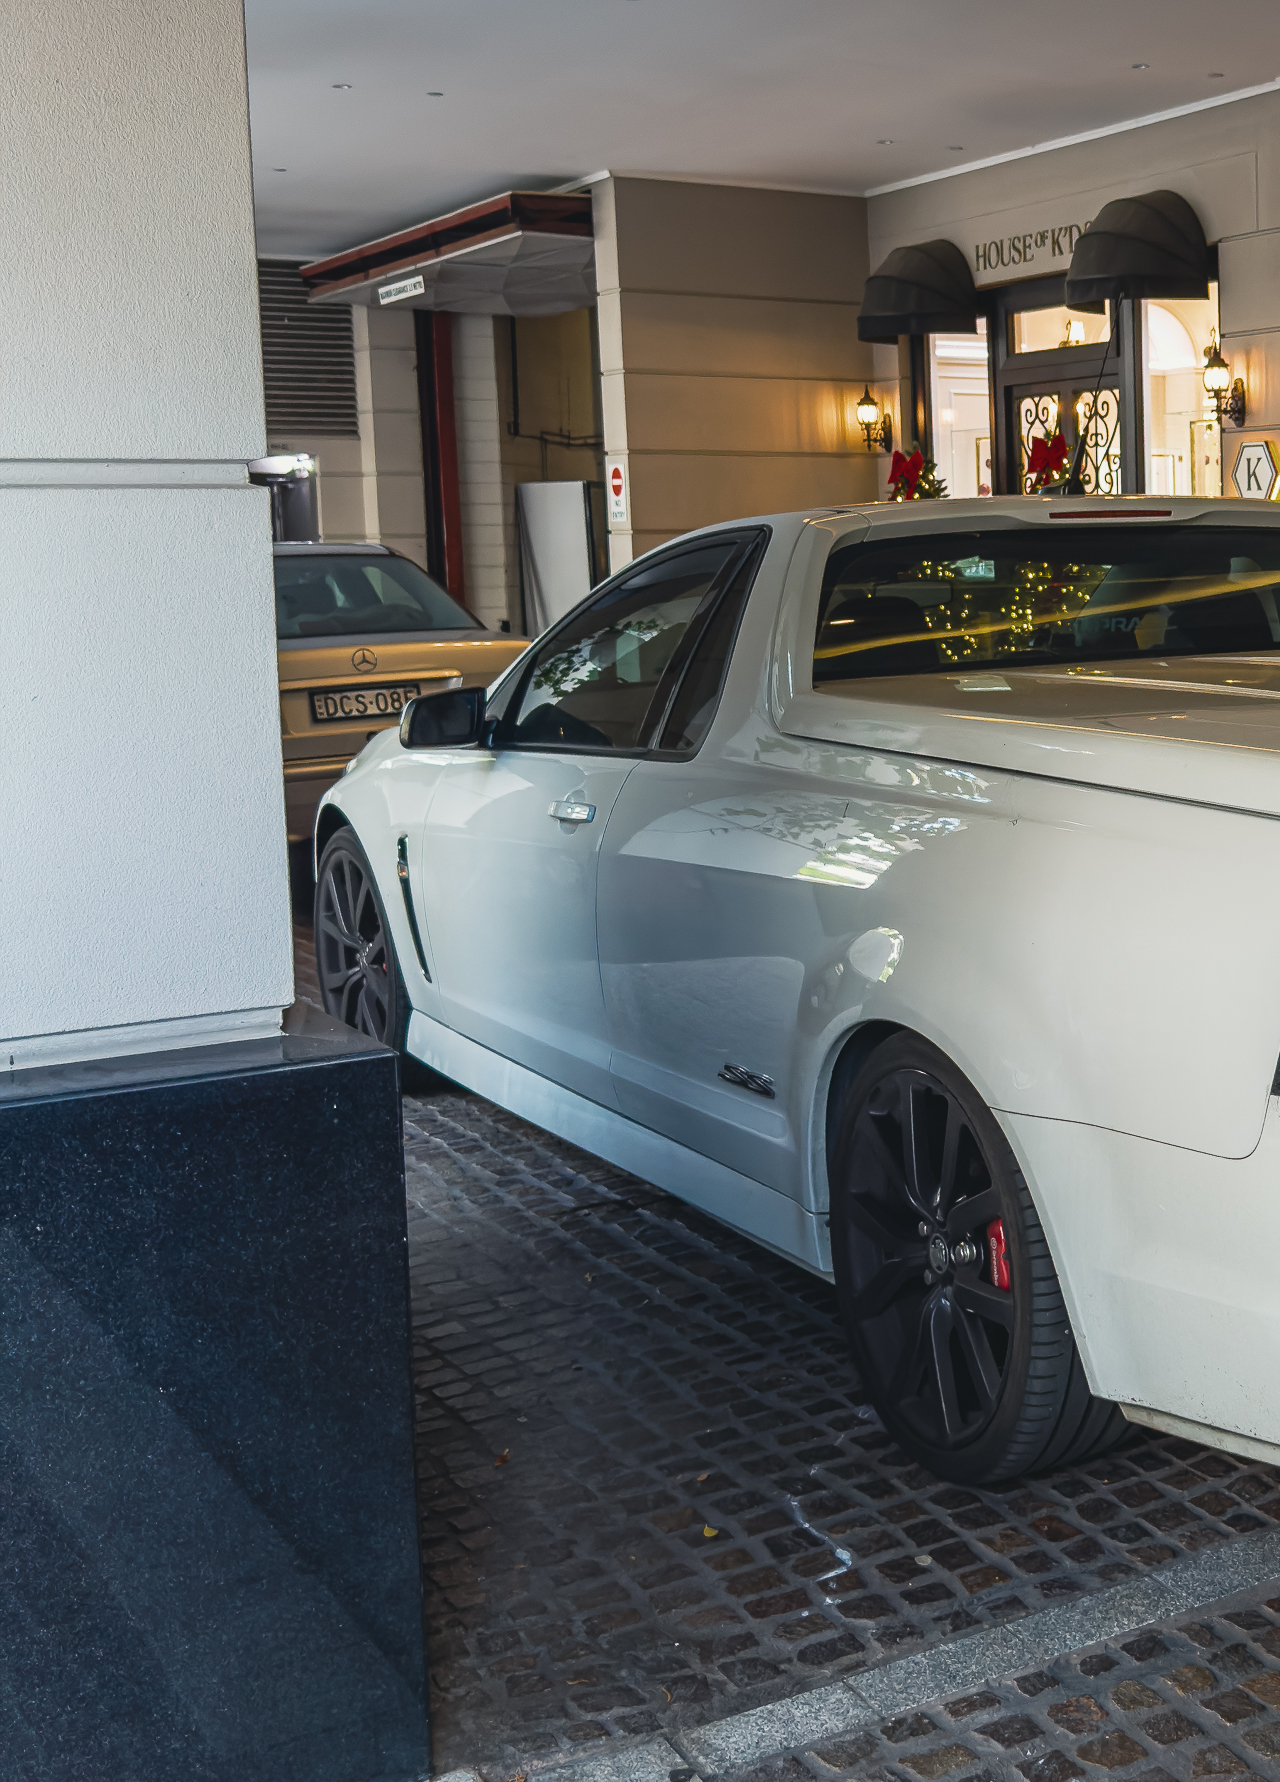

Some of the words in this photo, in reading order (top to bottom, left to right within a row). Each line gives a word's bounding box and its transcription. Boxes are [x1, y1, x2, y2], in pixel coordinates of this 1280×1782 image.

[975, 233, 1035, 272] HOUSE
[1034, 229, 1049, 249] OF
[1051, 221, 1092, 258] K'D
[1246, 457, 1263, 491] K
